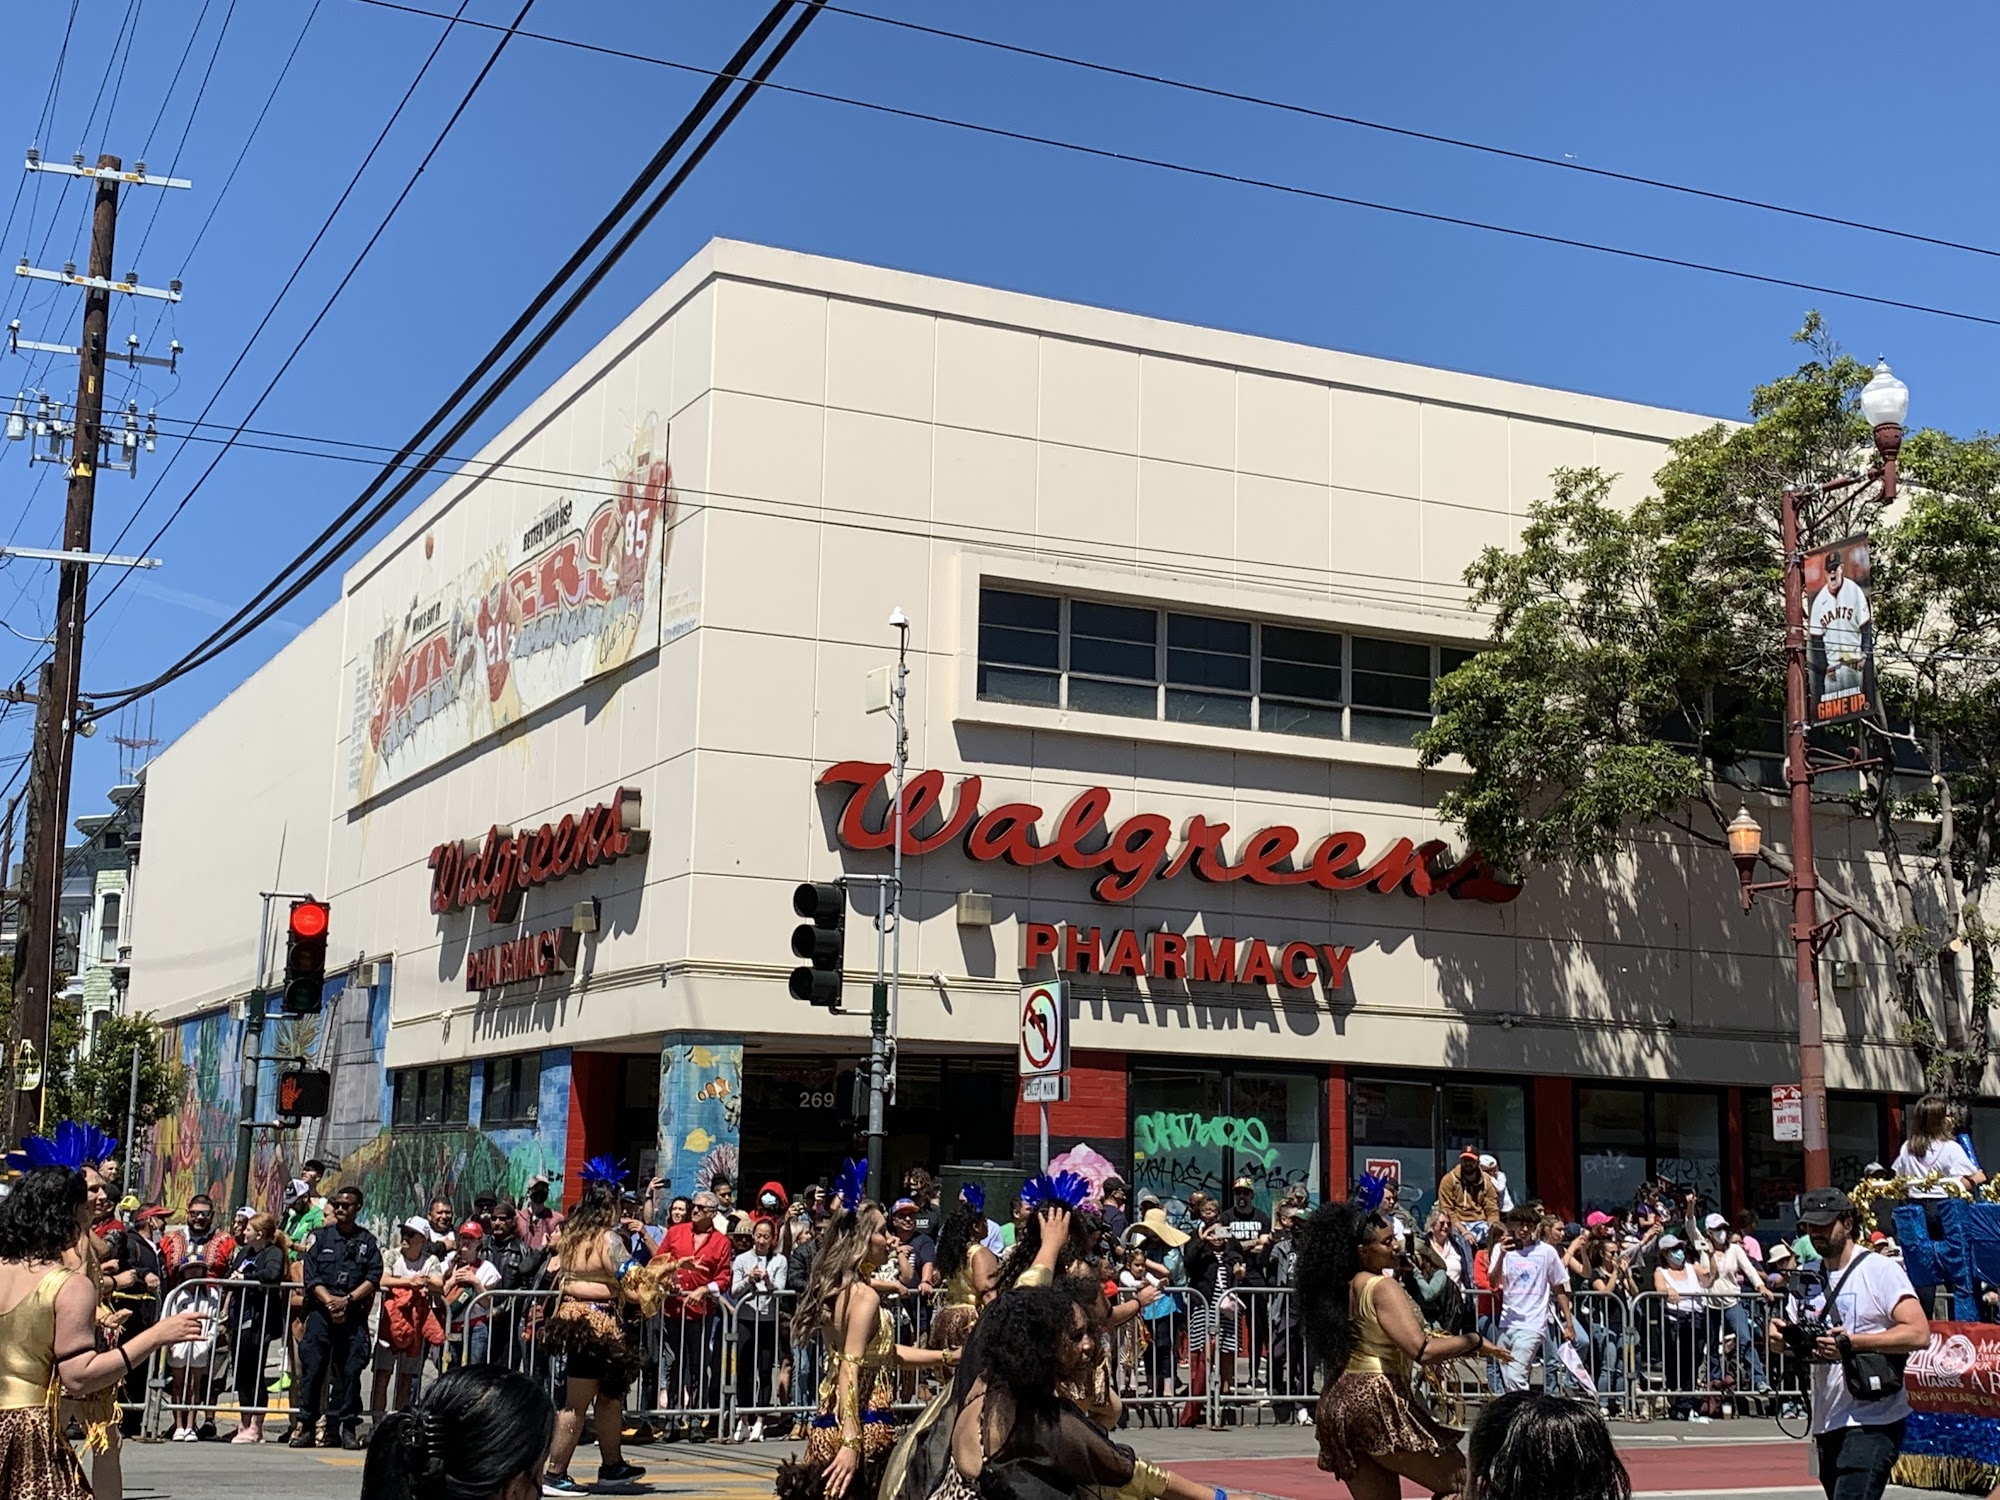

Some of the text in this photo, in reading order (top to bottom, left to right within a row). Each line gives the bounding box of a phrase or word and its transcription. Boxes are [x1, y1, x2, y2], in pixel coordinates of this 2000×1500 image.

[625, 508, 650, 558] 85
[1820, 607, 1853, 627] GIANTS
[486, 622, 503, 666] 21
[1817, 694, 1865, 720] GAME UP
[815, 759, 1524, 904] Walgreens
[428, 786, 643, 923] Walgreens
[466, 928, 568, 991] PHARMACY
[1024, 922, 1354, 990] PHARMACY
[799, 1092, 835, 1108] 269
[1776, 1115, 1786, 1125] ANY
[1930, 1393, 1943, 1402] 40
[1944, 1392, 1979, 1405] YEARS
